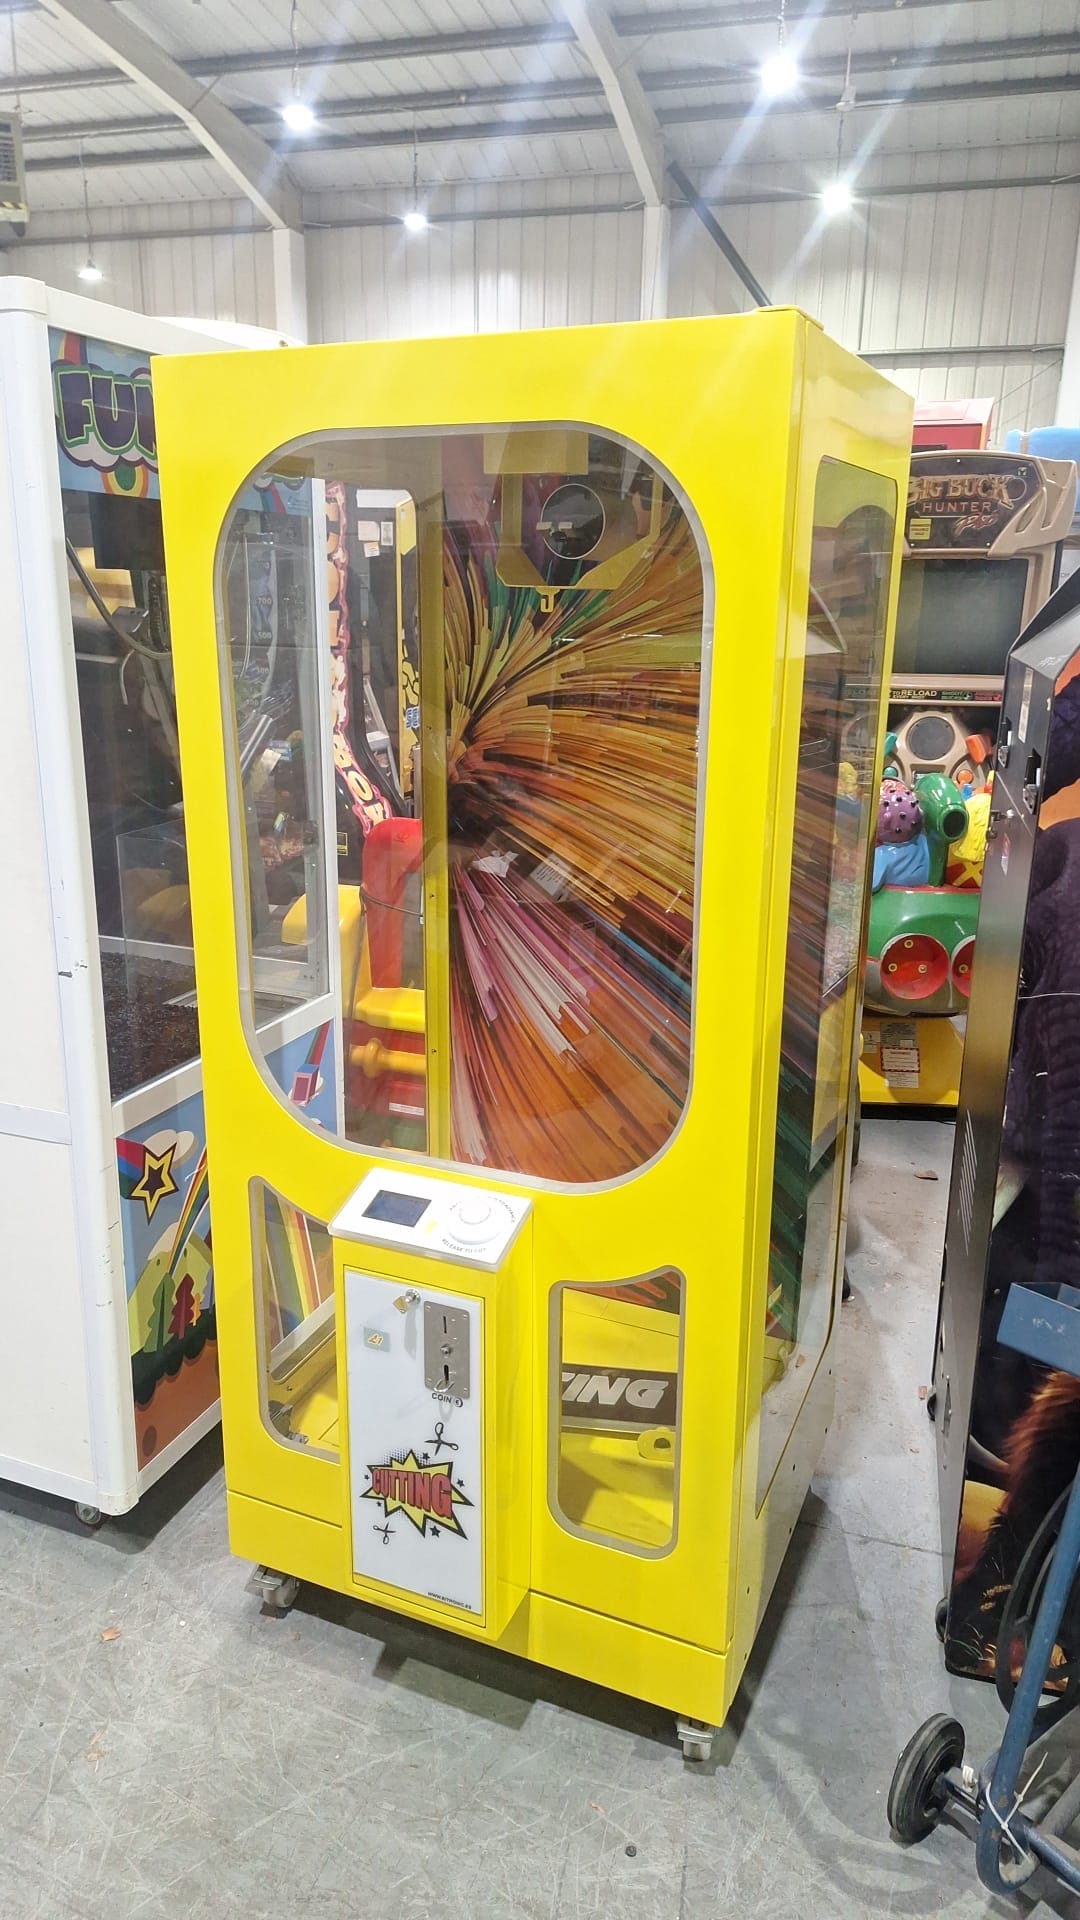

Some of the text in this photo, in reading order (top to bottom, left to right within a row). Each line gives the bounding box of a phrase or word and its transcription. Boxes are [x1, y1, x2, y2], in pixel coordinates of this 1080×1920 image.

[946, 474, 1014, 509] BUCK
[922, 501, 992, 513] HUNTER
[901, 689, 938, 697] RELOAD
[431, 1392, 452, 1404] COIN
[372, 1467, 453, 1521] CUTTING
